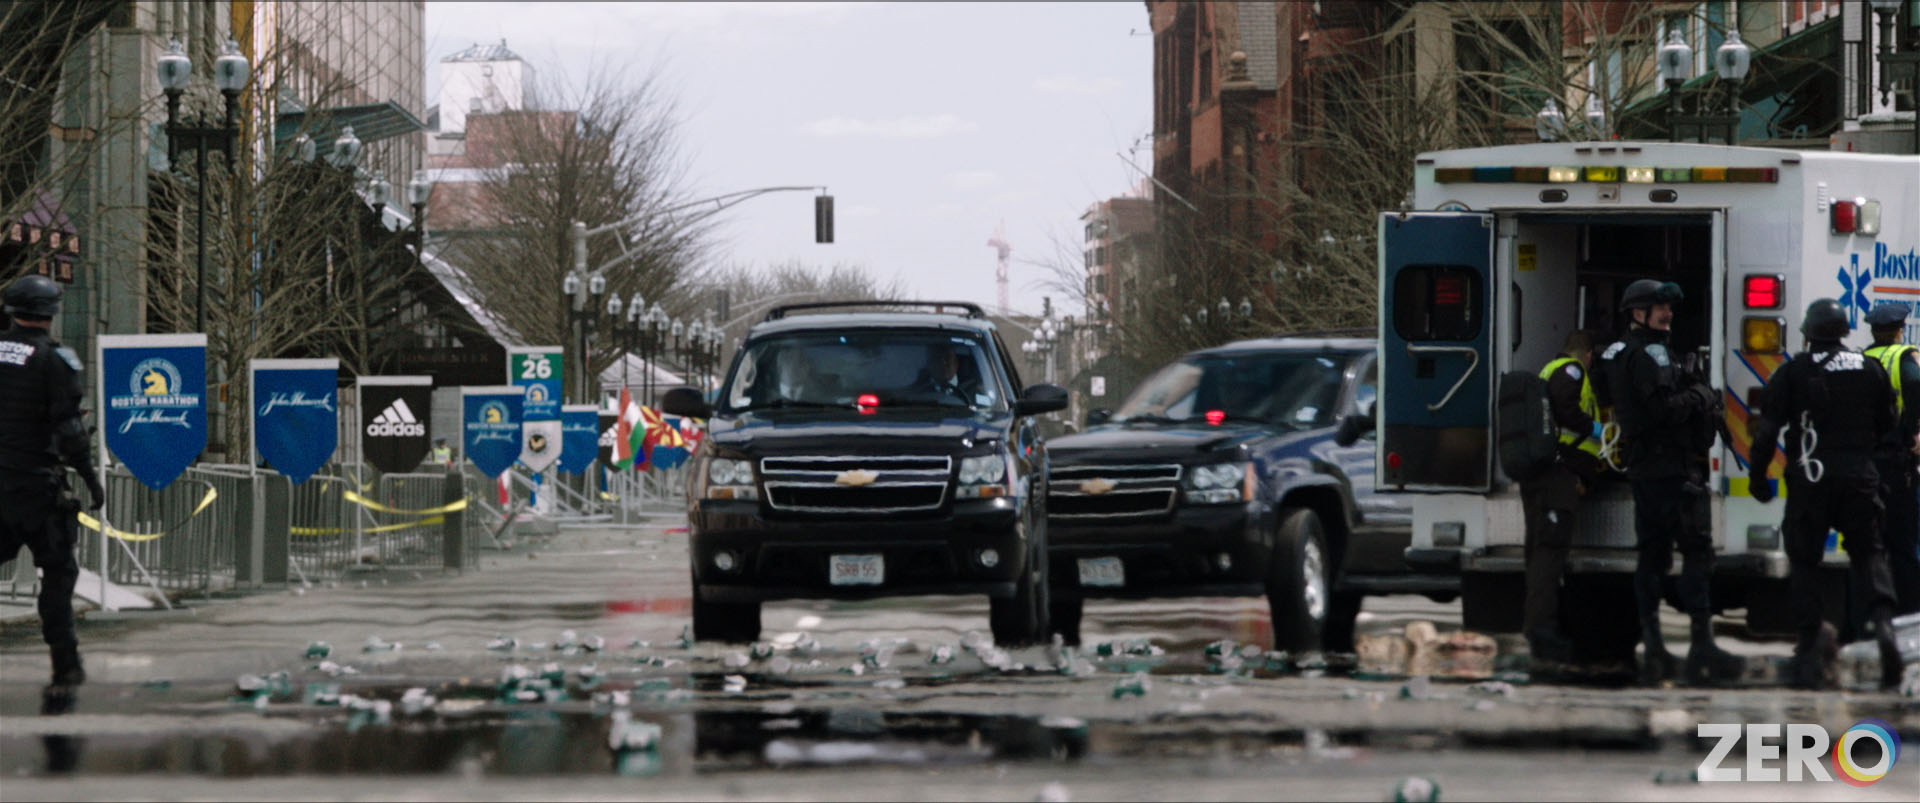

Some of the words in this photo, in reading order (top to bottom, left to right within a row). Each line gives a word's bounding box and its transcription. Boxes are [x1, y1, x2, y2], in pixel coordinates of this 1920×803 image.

[521, 359, 552, 379] 26
[1823, 359, 1865, 371] OLICE
[111, 396, 147, 407] BOSTON
[150, 395, 199, 406] MARATHON
[367, 422, 425, 437] adidas
